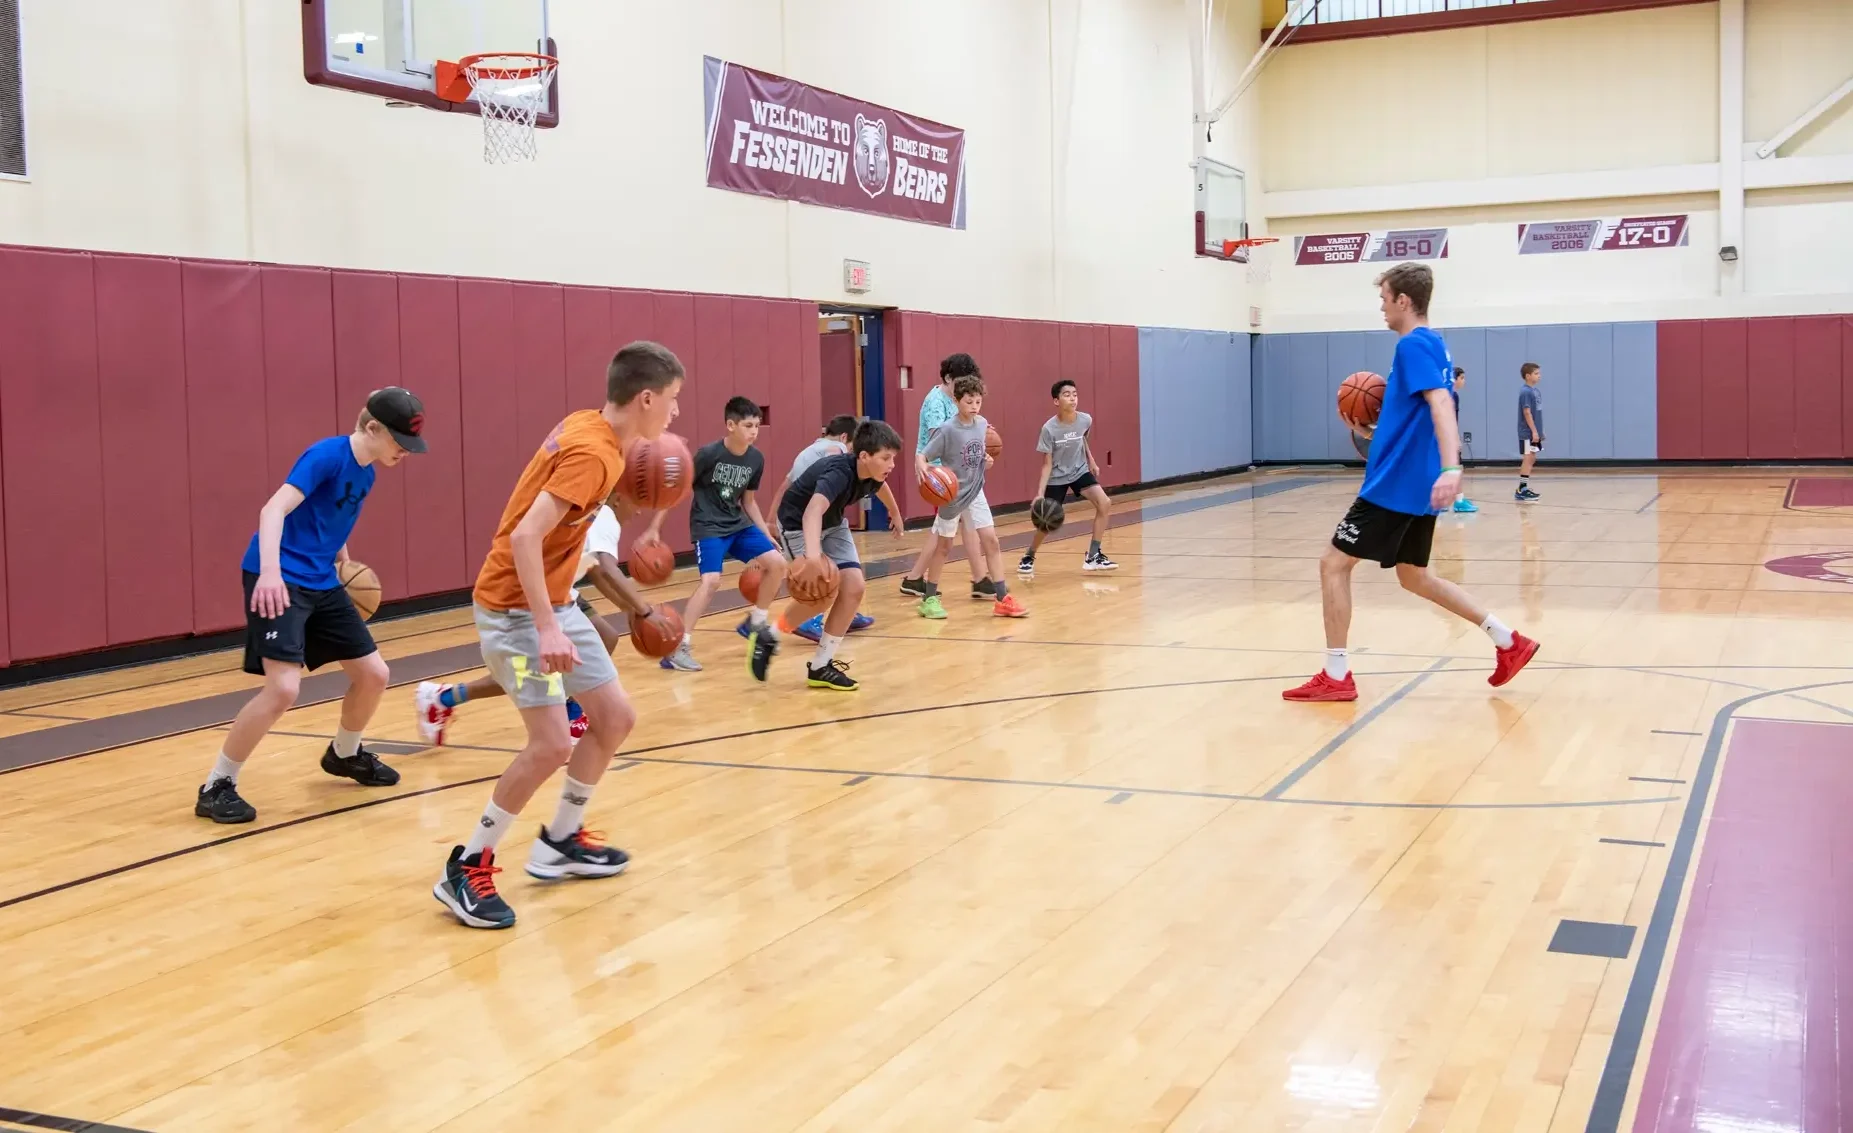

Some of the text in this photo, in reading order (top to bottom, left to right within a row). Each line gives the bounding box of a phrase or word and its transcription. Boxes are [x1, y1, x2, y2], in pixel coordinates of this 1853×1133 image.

[750, 98, 850, 146] WELCOME TO
[730, 119, 849, 185] FESSENDEN
[893, 135, 948, 164] HOME OF THE
[893, 156, 948, 205] BEARS
[1197, 183, 1204, 192] 5
[1553, 224, 1592, 232] VARSITY
[1326, 236, 1362, 245] VARSITY
[1533, 231, 1590, 241] BASKETBALL
[1618, 226, 1671, 246] 17-0
[1307, 243, 1360, 253] BASKETBALL
[1385, 239, 1432, 258] 18-0
[1551, 239, 1584, 250] 2006
[1324, 251, 1355, 262] 2005
[712, 462, 753, 487] CELTICS
